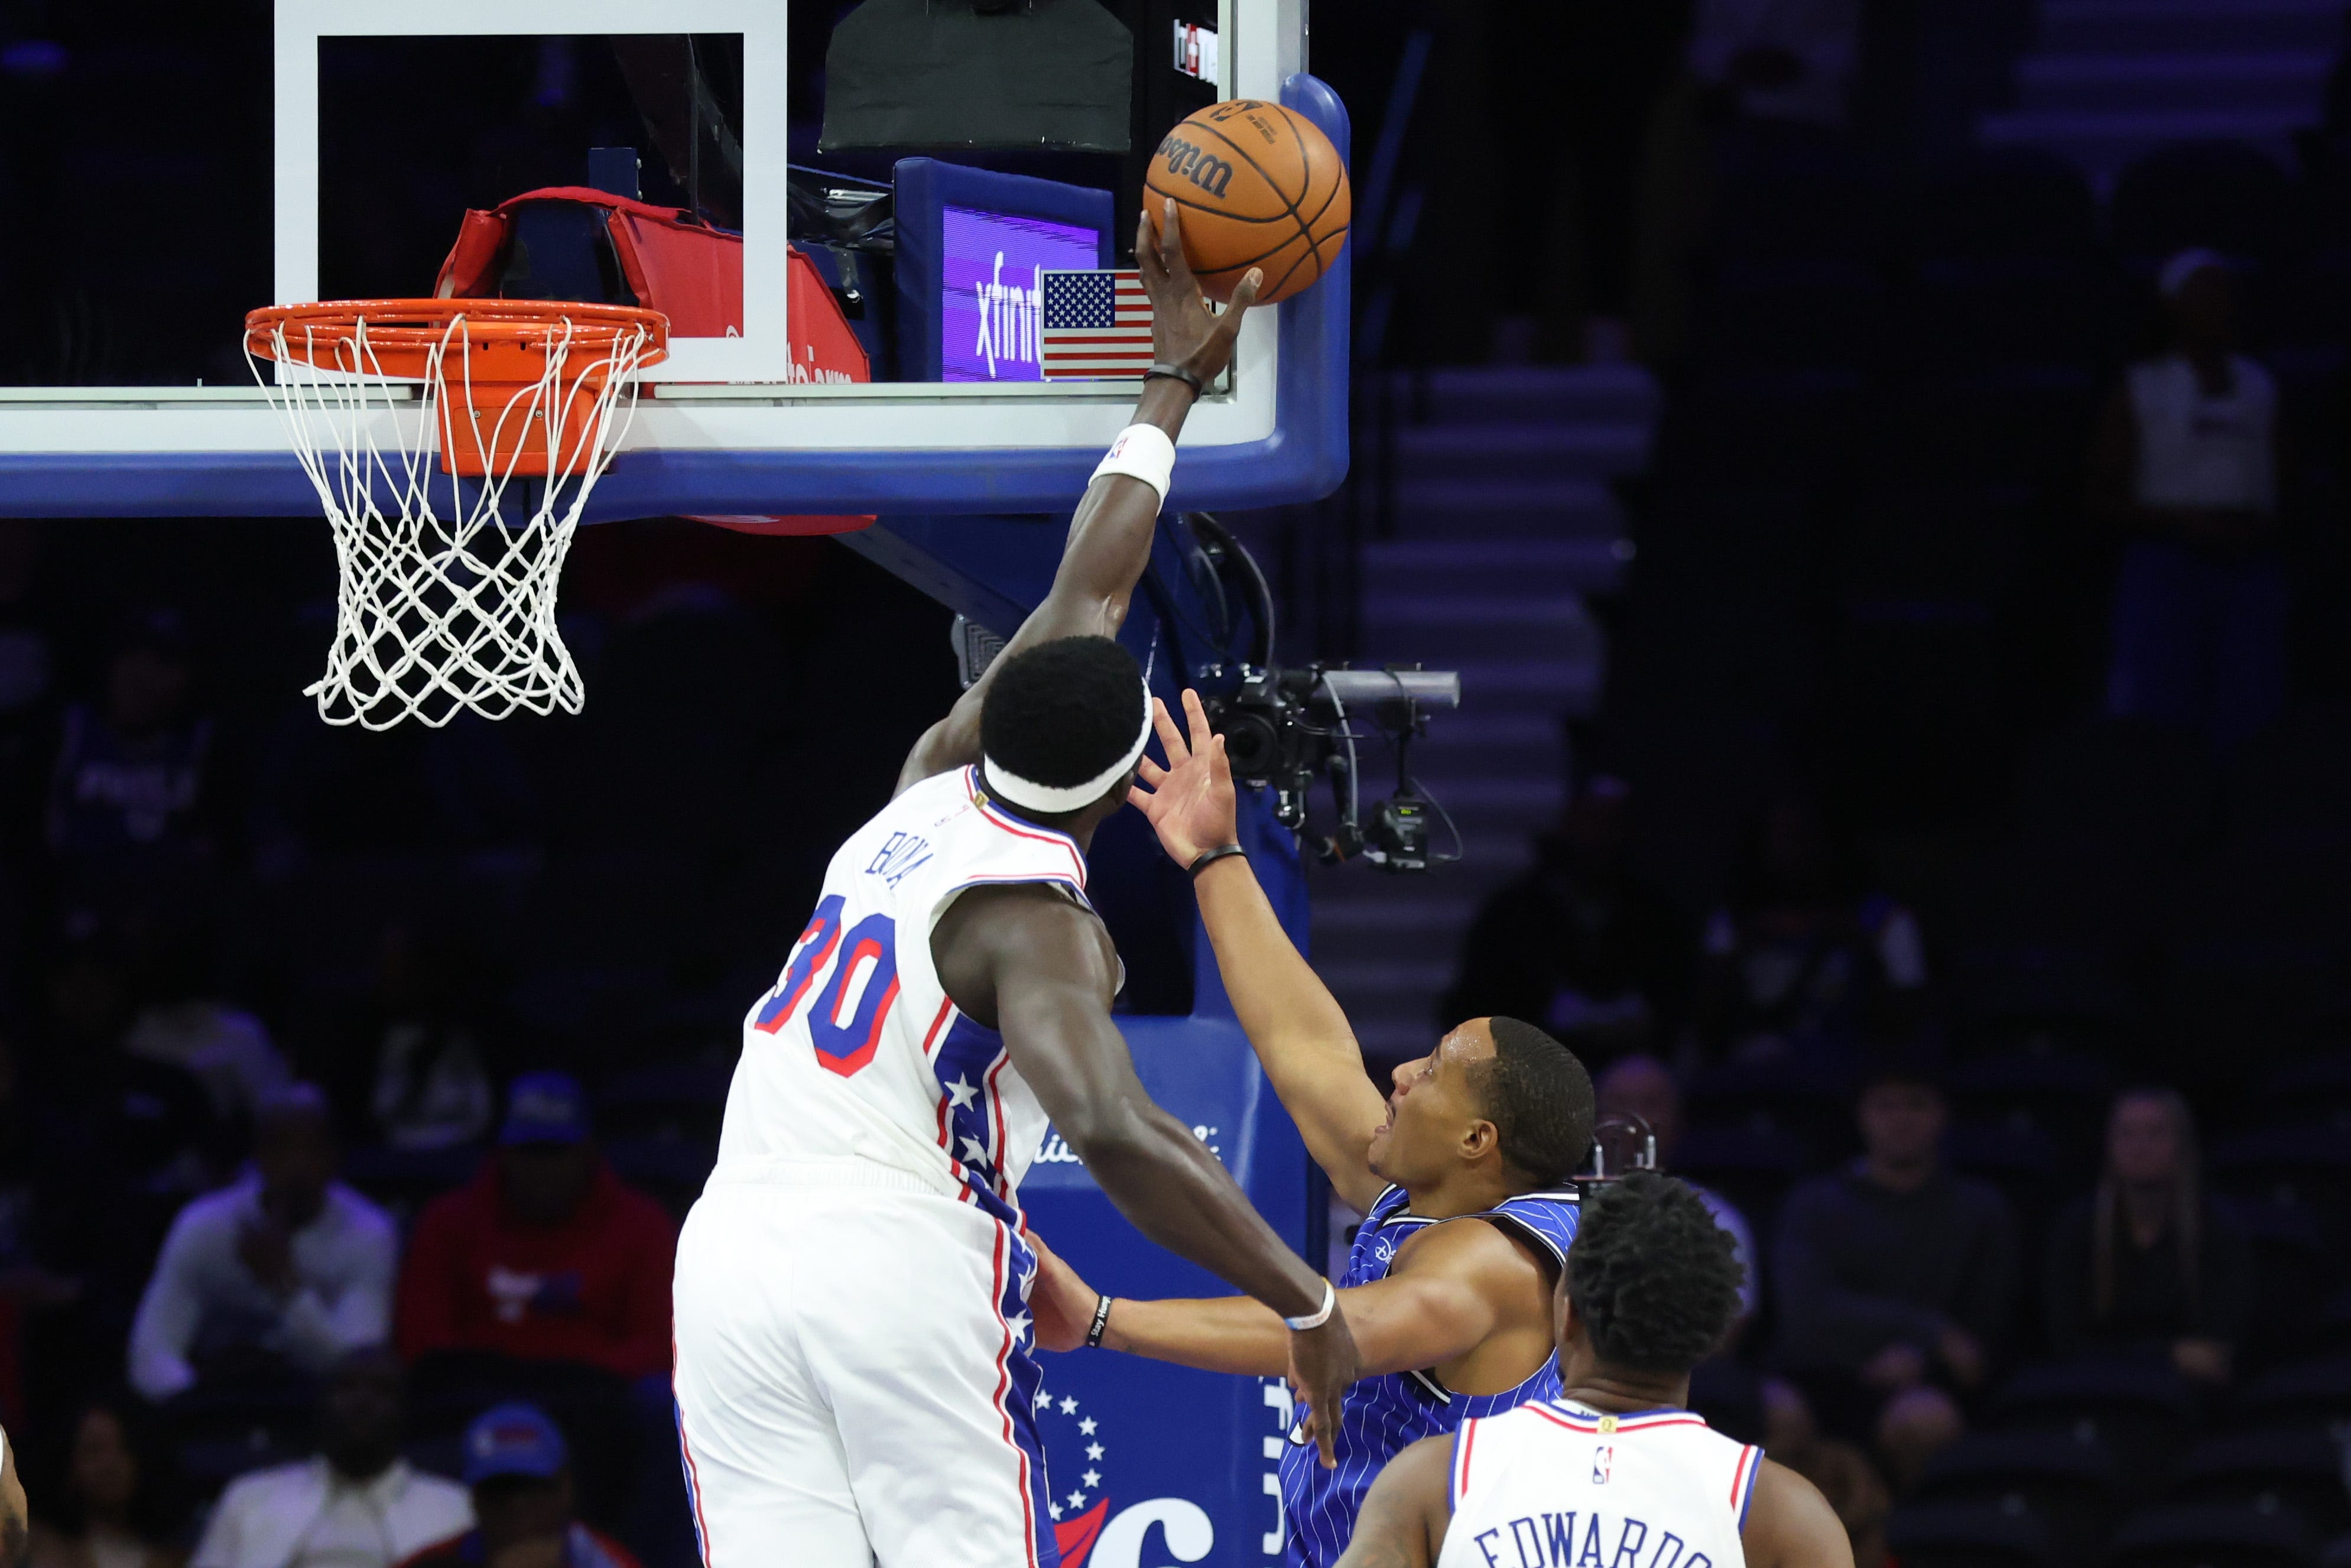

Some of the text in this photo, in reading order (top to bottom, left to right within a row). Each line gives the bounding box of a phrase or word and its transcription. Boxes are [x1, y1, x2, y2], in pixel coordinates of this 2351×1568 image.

[1157, 137, 1233, 199] Wilso
[975, 251, 1041, 379] xfinit
[754, 893, 901, 1079] 30
[1091, 1319, 1105, 1336] Stay
[1097, 1296, 1111, 1318] Hung
